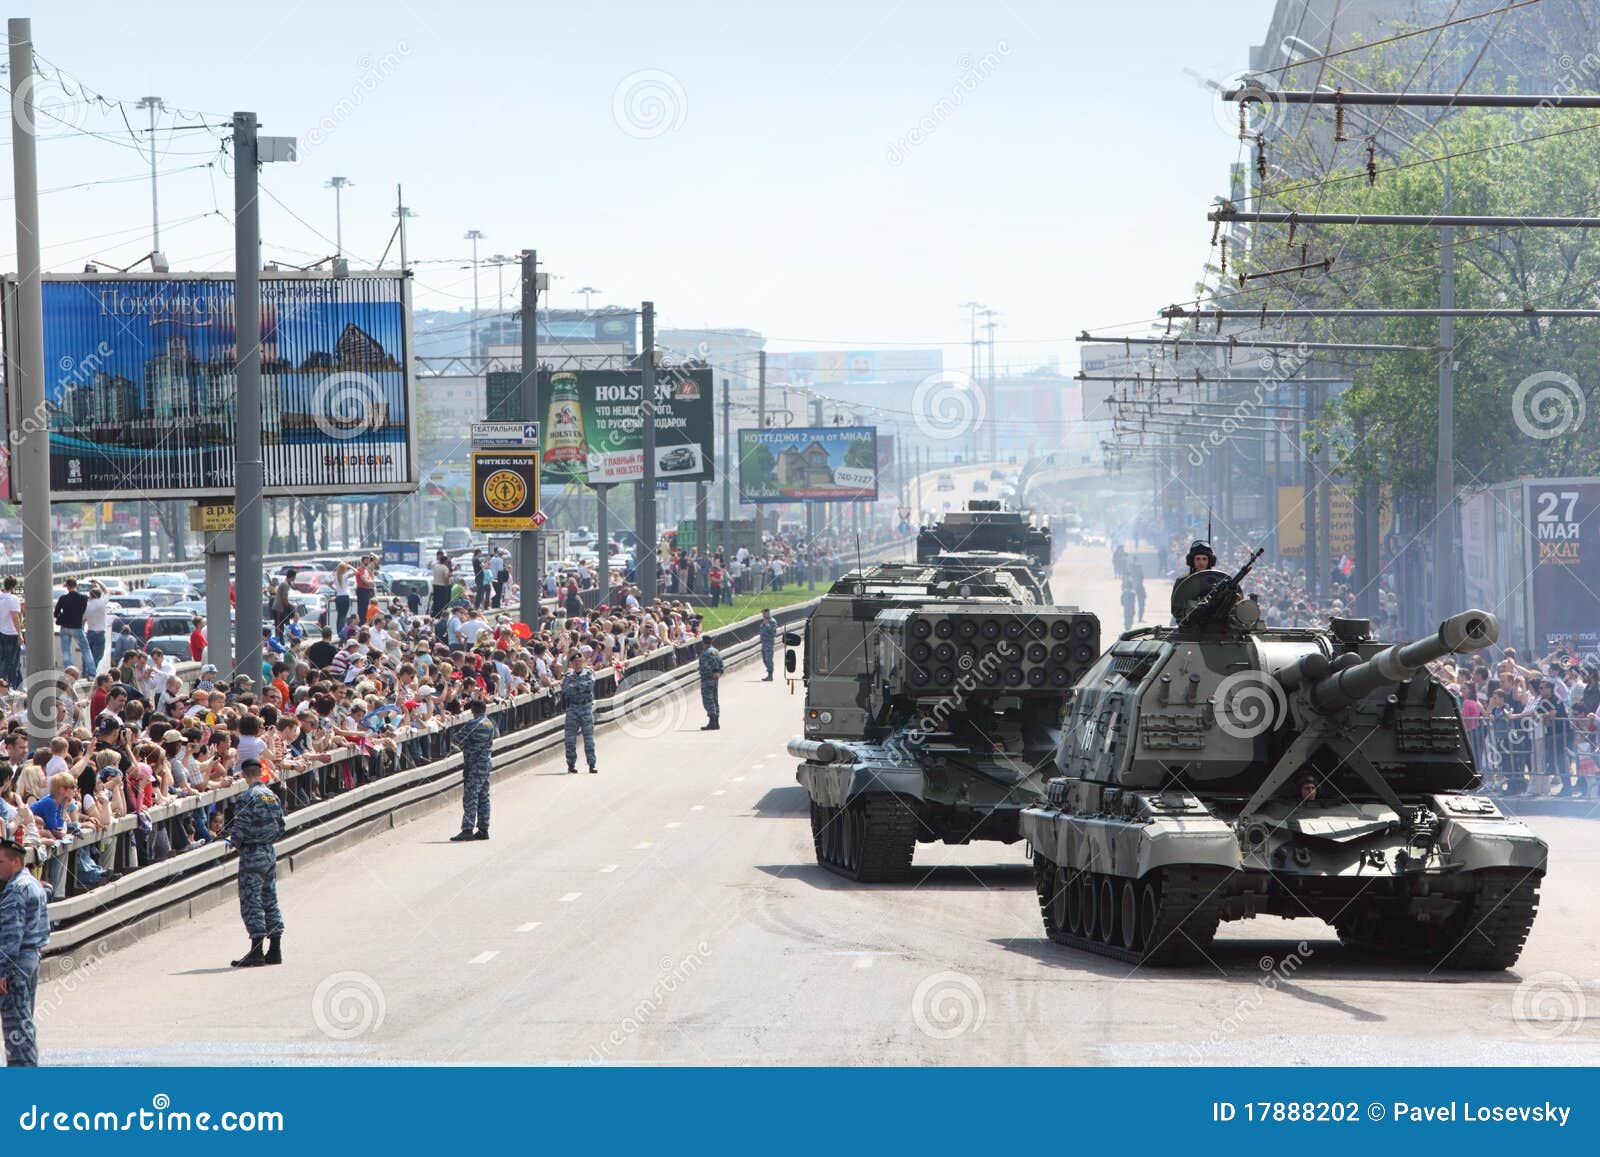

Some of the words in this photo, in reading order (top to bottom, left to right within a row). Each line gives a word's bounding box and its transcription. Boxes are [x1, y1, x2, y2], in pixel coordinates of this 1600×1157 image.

[596, 405, 611, 417] ЧТО
[474, 425, 523, 433] ТЕАТРАЛЬНАЯ
[596, 419, 607, 430] ТО
[743, 431, 800, 444] КОТТЕДЖИ
[801, 432, 808, 442] 2
[839, 431, 872, 443] МКАД
[477, 458, 512, 466] ФИТНЕС
[1537, 492, 1580, 522] 27
[1538, 522, 1580, 540] МАЯ
[1539, 542, 1580, 558] МХАТ
